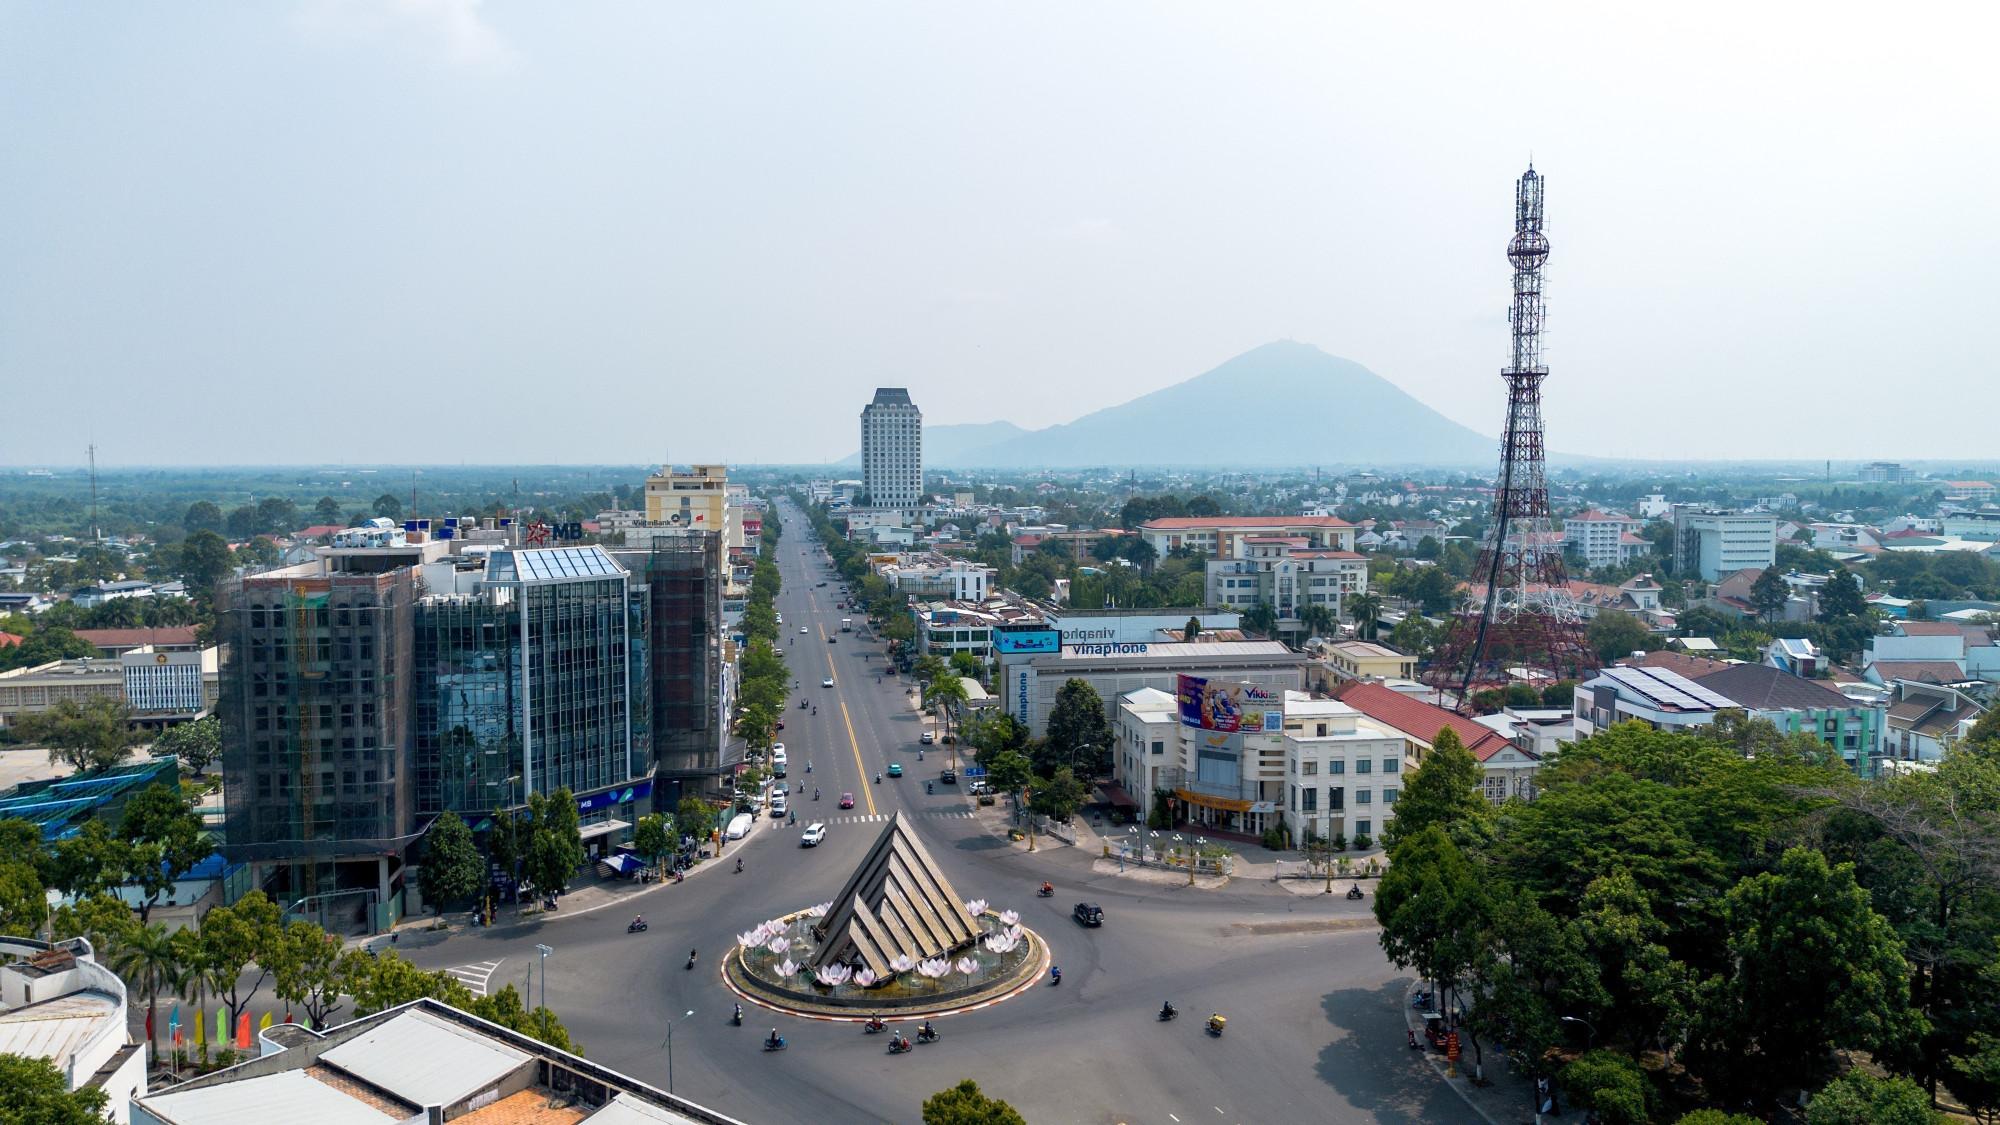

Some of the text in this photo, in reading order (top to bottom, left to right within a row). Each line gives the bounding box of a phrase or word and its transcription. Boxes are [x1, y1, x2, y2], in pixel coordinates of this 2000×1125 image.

[553, 522, 582, 540] MB
[1073, 642, 1148, 657] vinaphone
[1019, 672, 1029, 725] vinaphone
[1245, 686, 1268, 698] Vikki
[580, 800, 592, 808] MB
